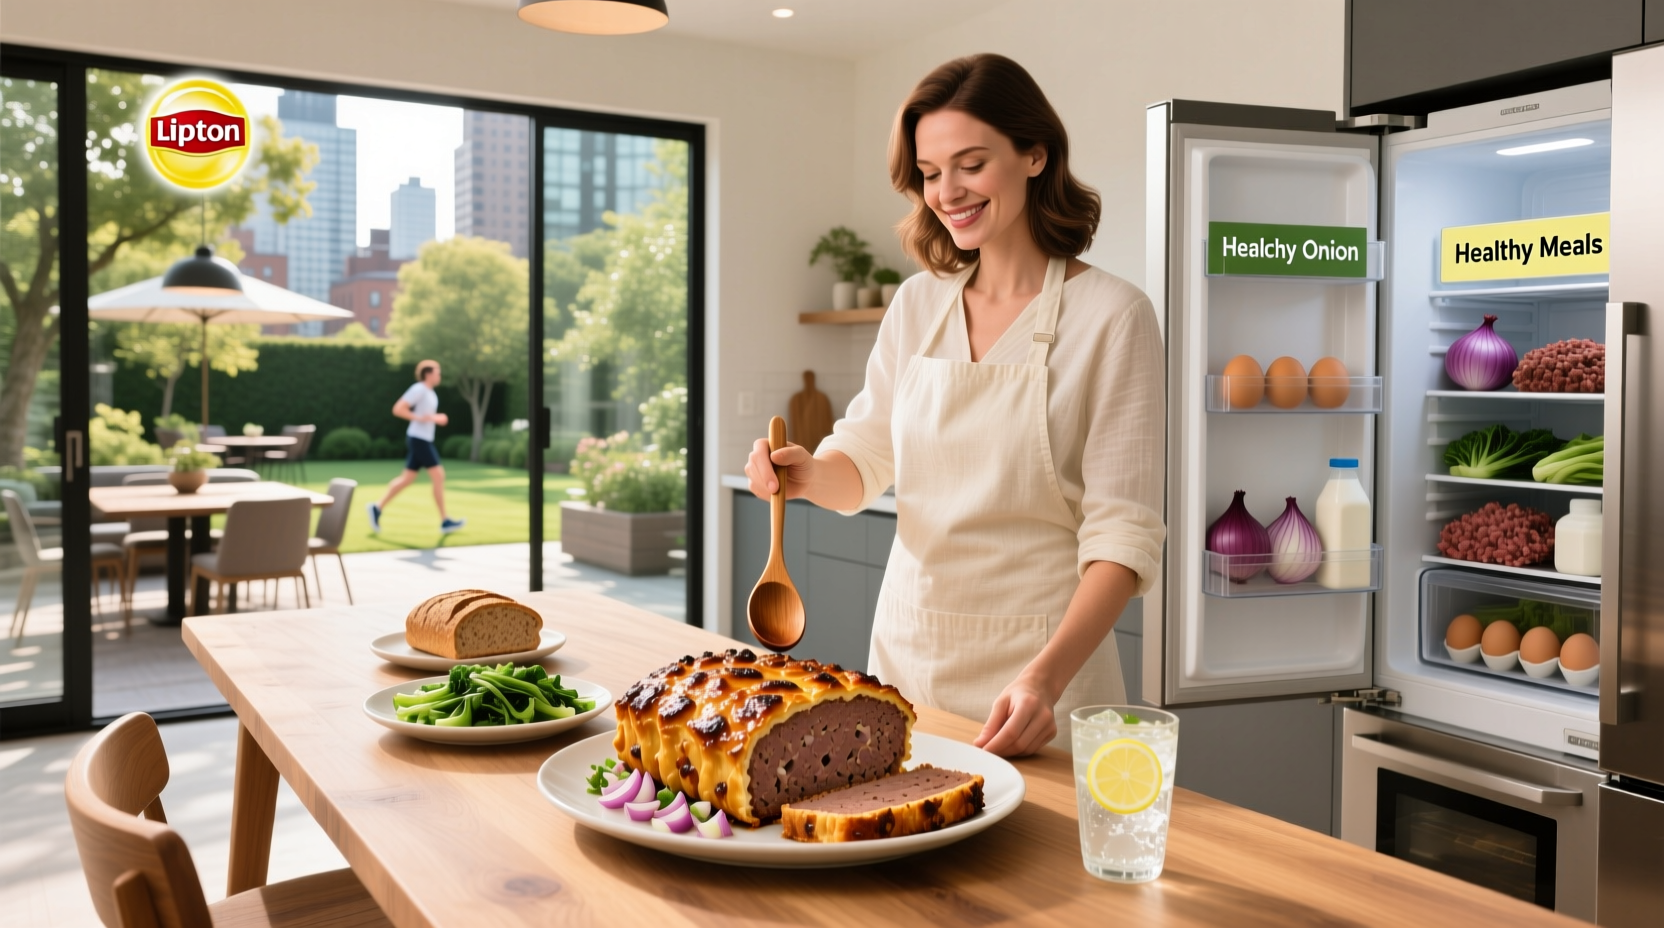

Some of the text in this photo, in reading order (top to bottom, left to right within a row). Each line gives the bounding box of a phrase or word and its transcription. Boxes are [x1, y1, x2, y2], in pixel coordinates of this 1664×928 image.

[1222, 236, 1359, 265] Healchy Onion
[1455, 232, 1603, 266] Healthy Meals
